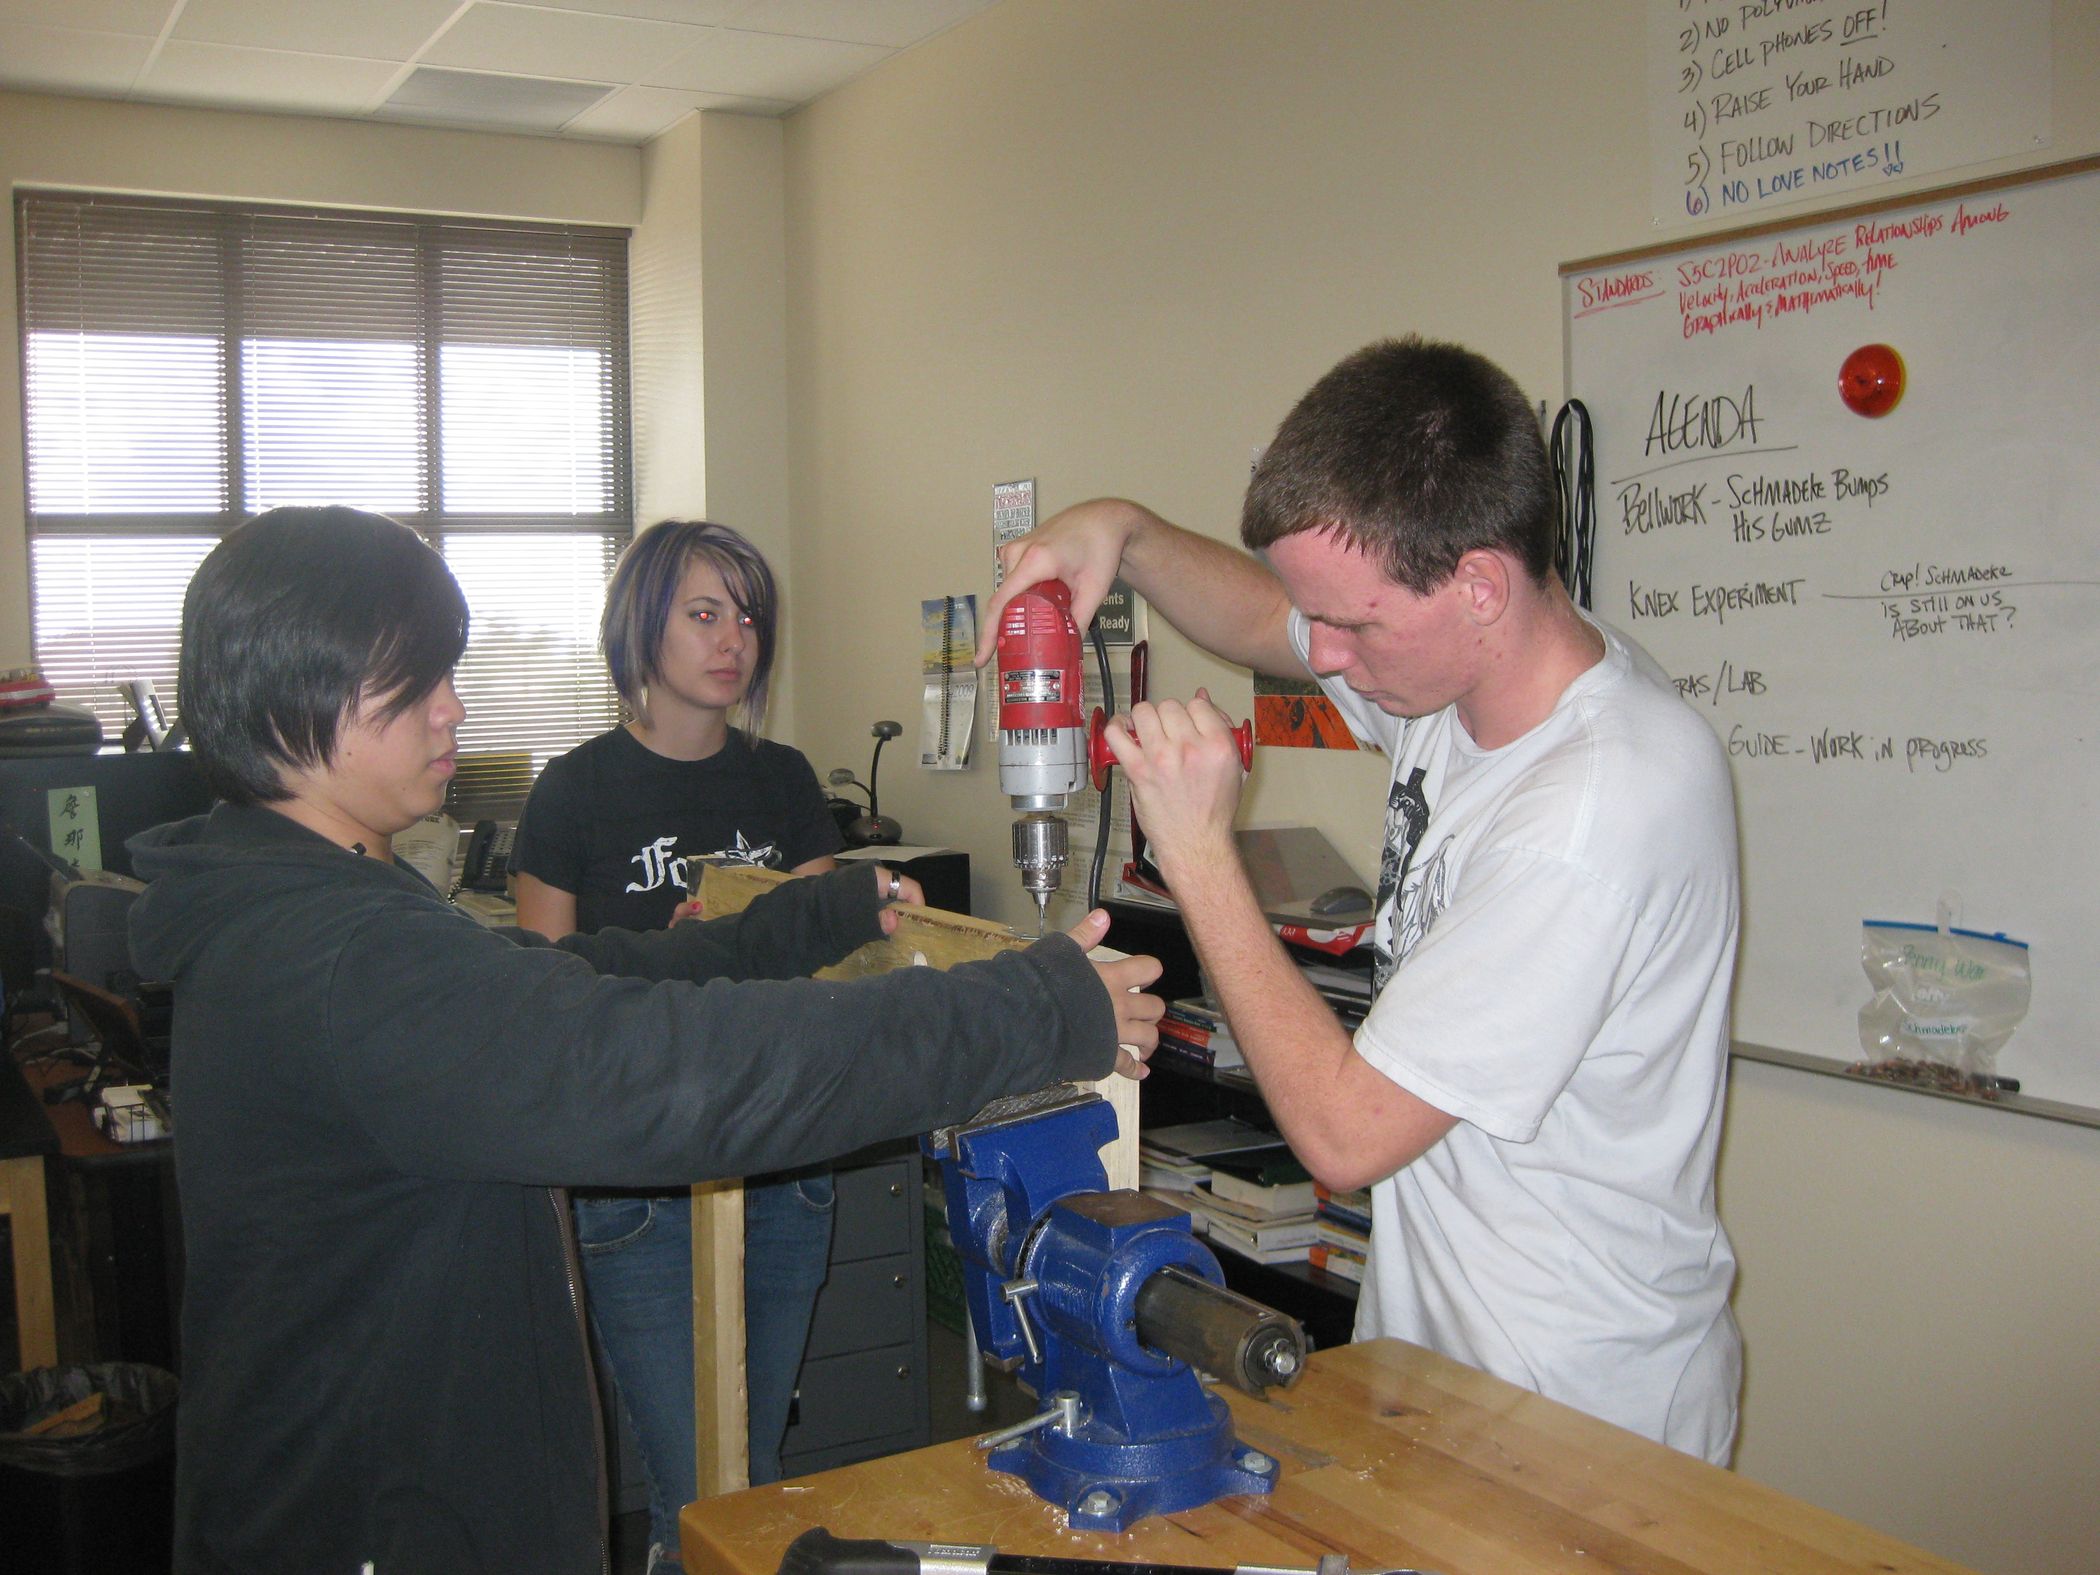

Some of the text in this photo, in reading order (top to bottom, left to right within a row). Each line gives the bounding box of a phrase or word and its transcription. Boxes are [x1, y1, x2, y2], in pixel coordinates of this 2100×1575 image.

[1678, 0, 1887, 93] 3) CELL PHONES OFF!
[1680, 21, 1700, 54] 2)
[1705, 18, 1729, 39] NO
[1684, 56, 1895, 140] 4) RAISE YOUR HAND
[1684, 93, 1941, 189] 5) FOLLOW DIRECTIONS
[1722, 183, 1749, 206] NO
[1757, 168, 1804, 199] LOVE
[1645, 384, 1765, 457] AGENDA
[1629, 580, 1679, 620] KNEX
[1955, 595, 1975, 610] ON
[1980, 590, 2003, 607] US
[1099, 615, 1130, 632] Ready
[1727, 724, 1790, 759] GUIDE
[1811, 727, 1864, 764] WORK
